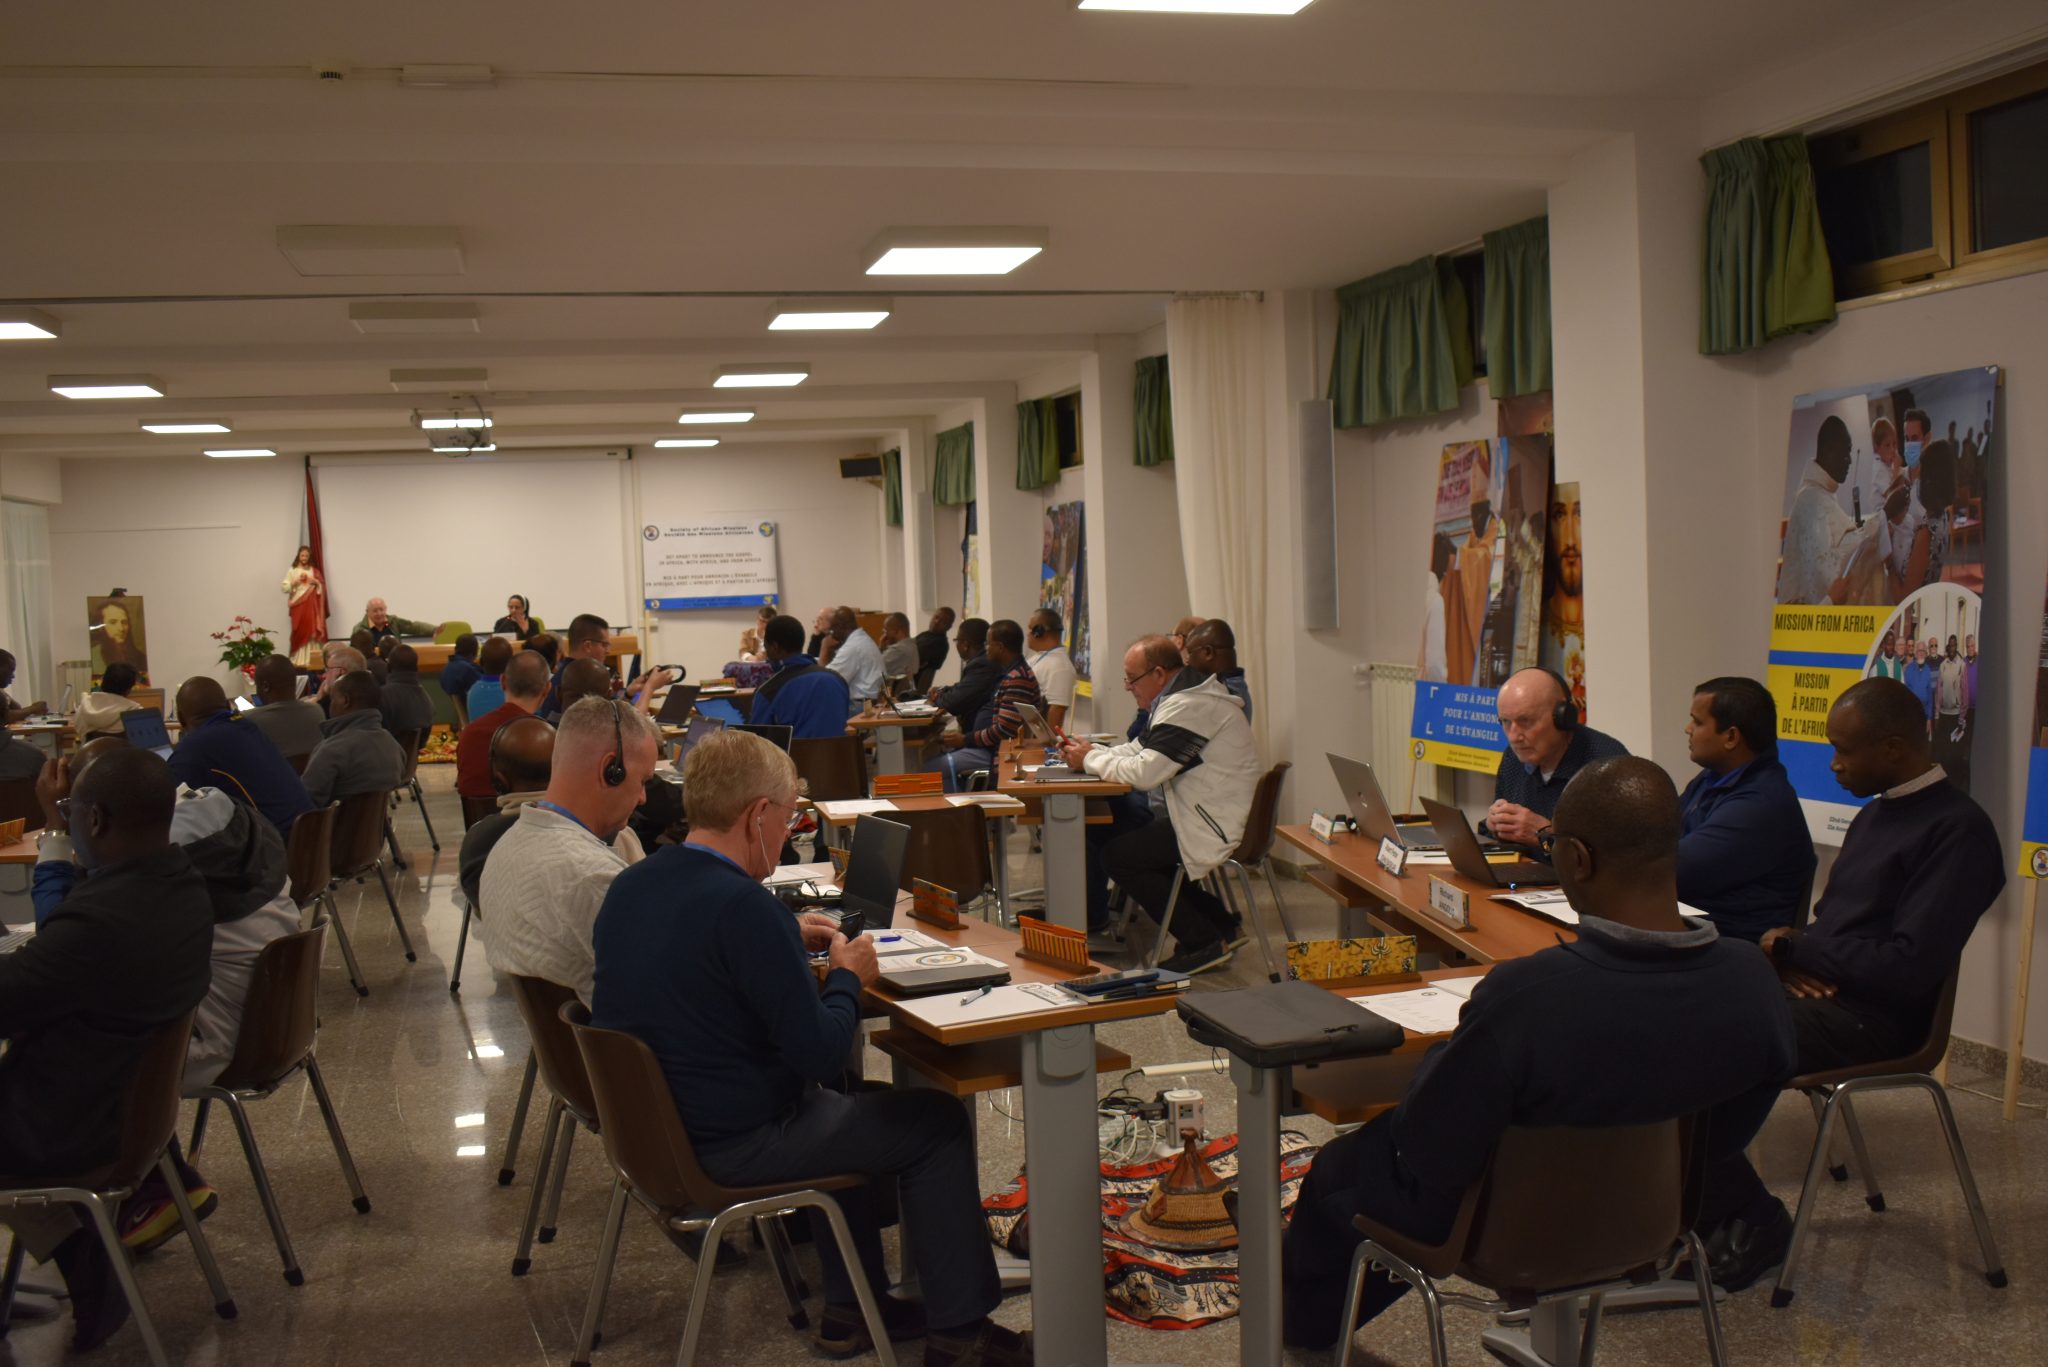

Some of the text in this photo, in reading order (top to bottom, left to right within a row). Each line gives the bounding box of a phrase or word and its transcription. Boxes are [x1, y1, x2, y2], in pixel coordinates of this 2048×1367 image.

[1774, 613, 1875, 633] MISSION FROM AFRICA
[1794, 672, 1830, 690] MISSION
[1455, 692, 1496, 706] MIS À PART
[1792, 692, 1828, 713] À PARTIR
[1443, 707, 1462, 719] POUR
[1445, 724, 1499, 741] DE L'ÉVANGILE
[1781, 718, 1792, 734] DE
